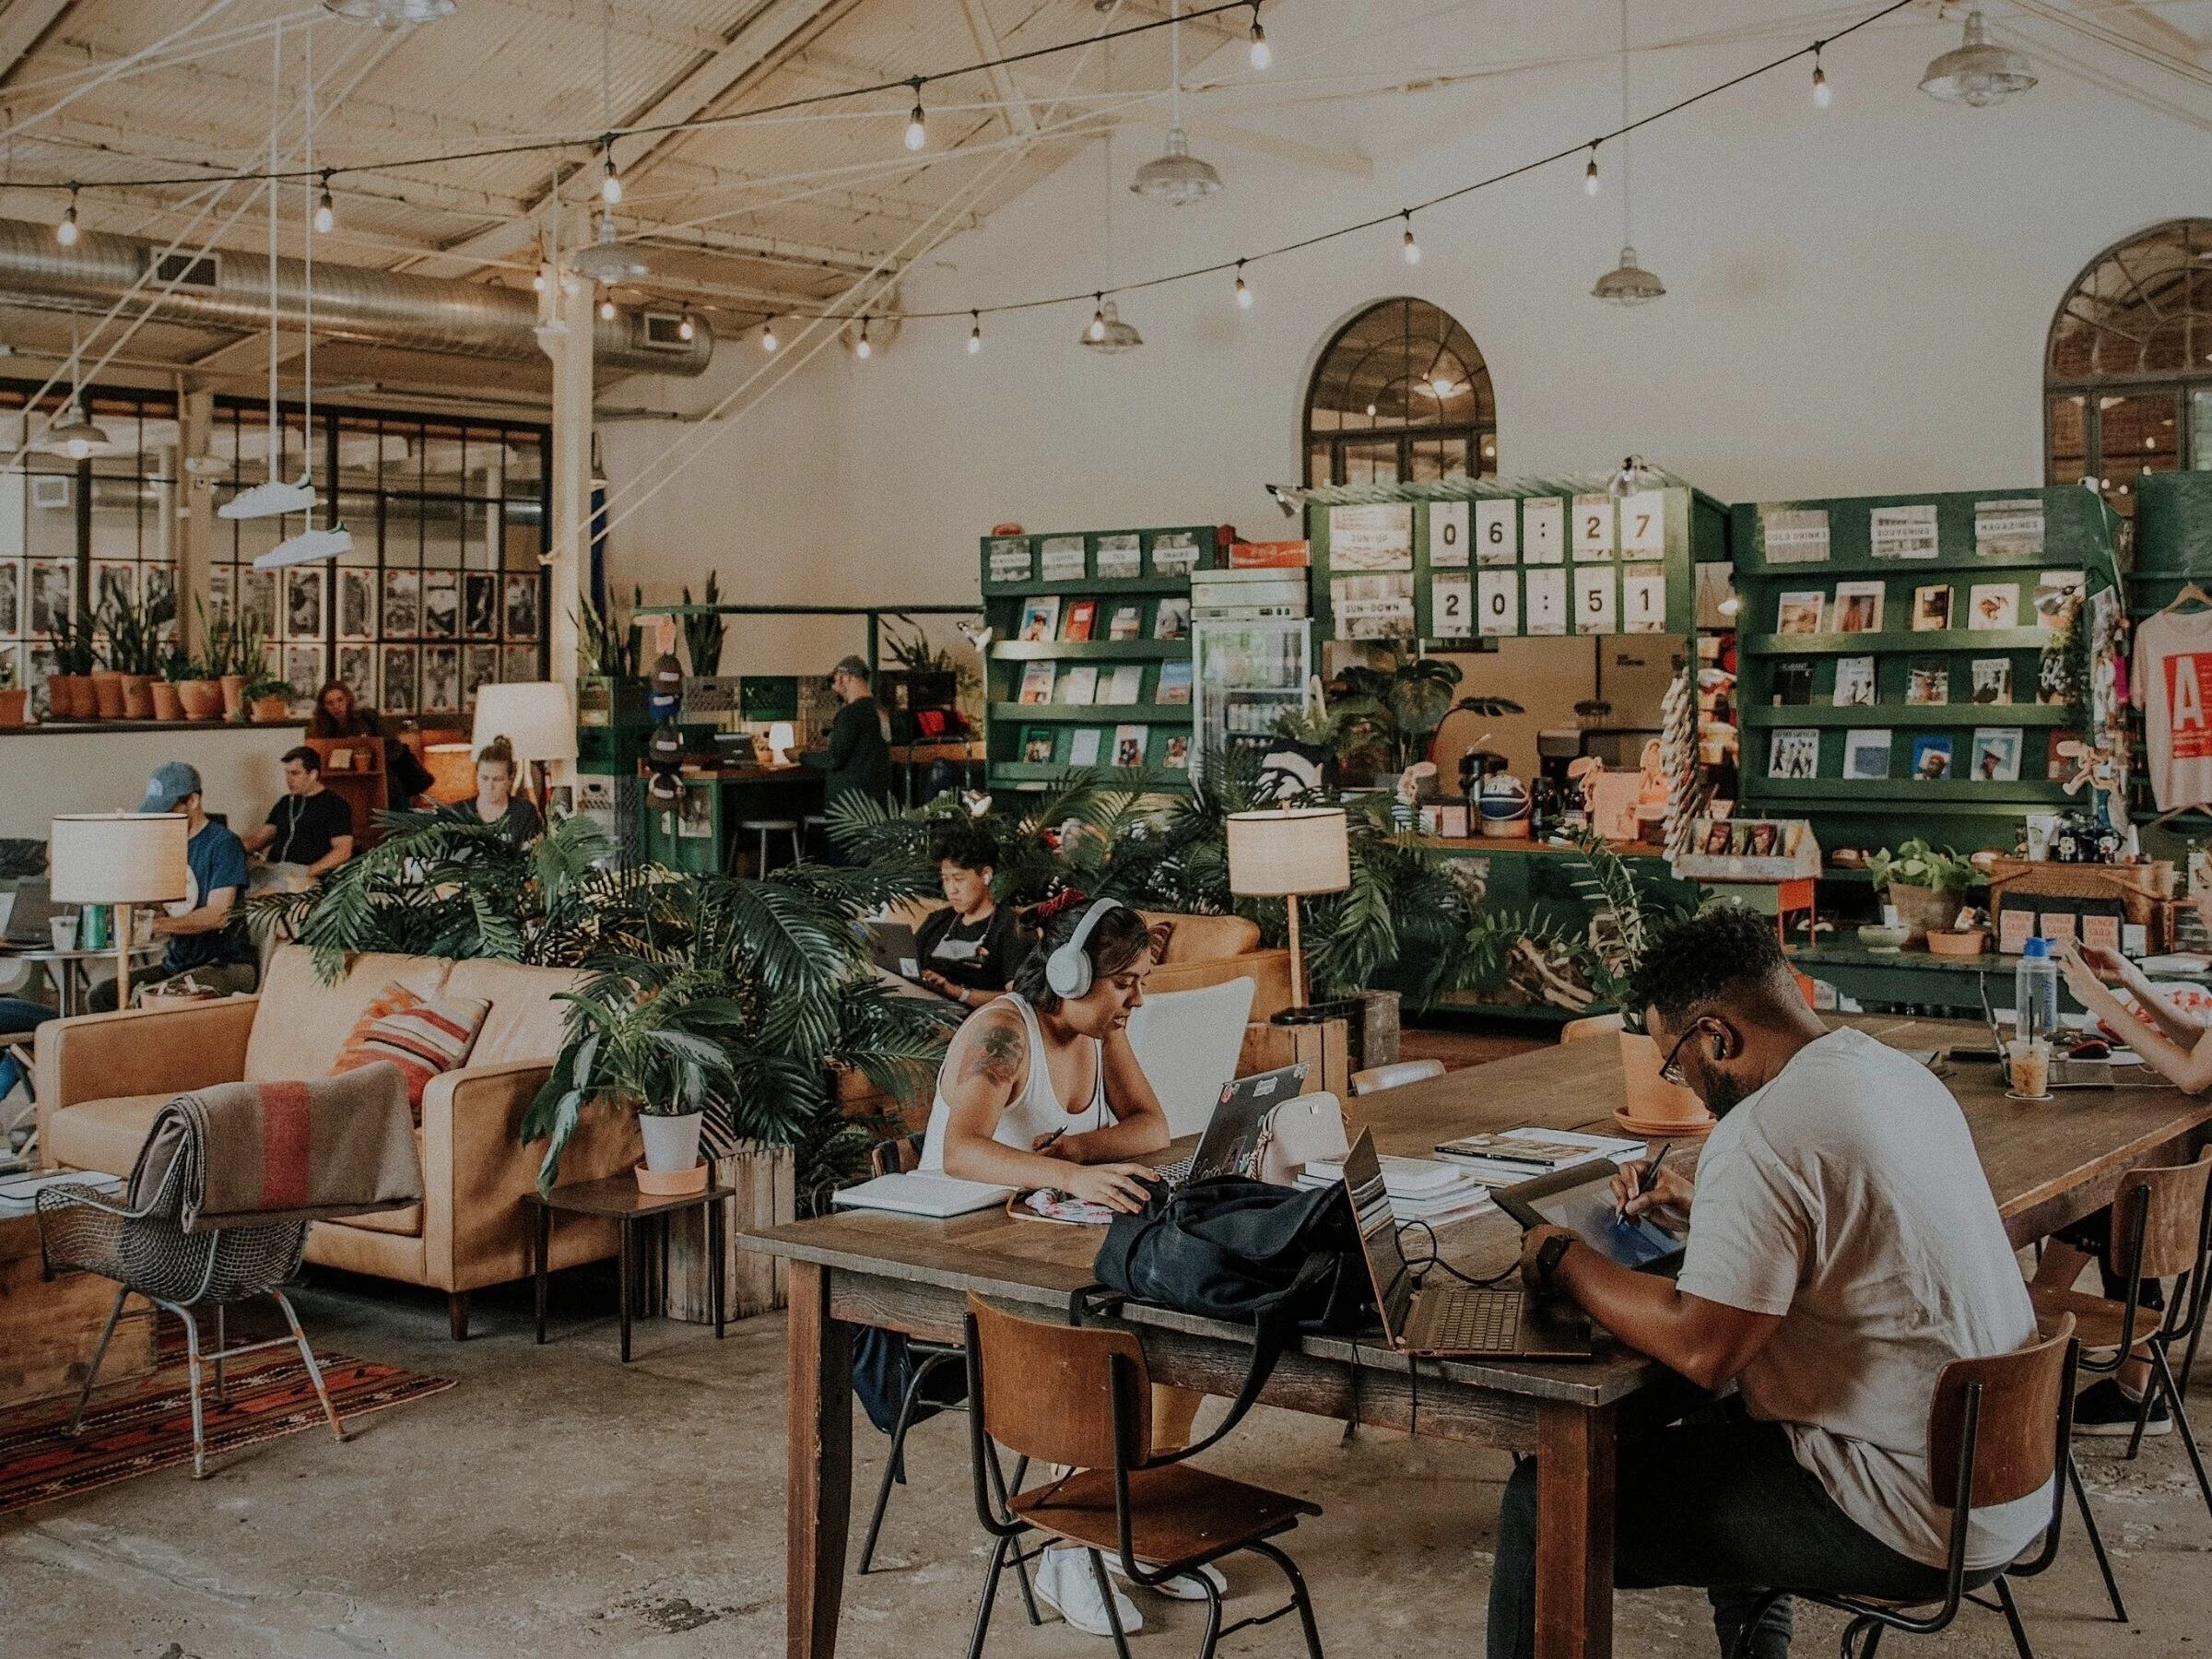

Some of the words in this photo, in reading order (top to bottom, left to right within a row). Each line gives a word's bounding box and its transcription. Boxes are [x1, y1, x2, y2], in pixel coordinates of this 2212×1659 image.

[1981, 521, 2038, 532] MAGAZINES
[1346, 602, 1399, 614] SUN-DOWN
[2172, 655, 2206, 730] A
